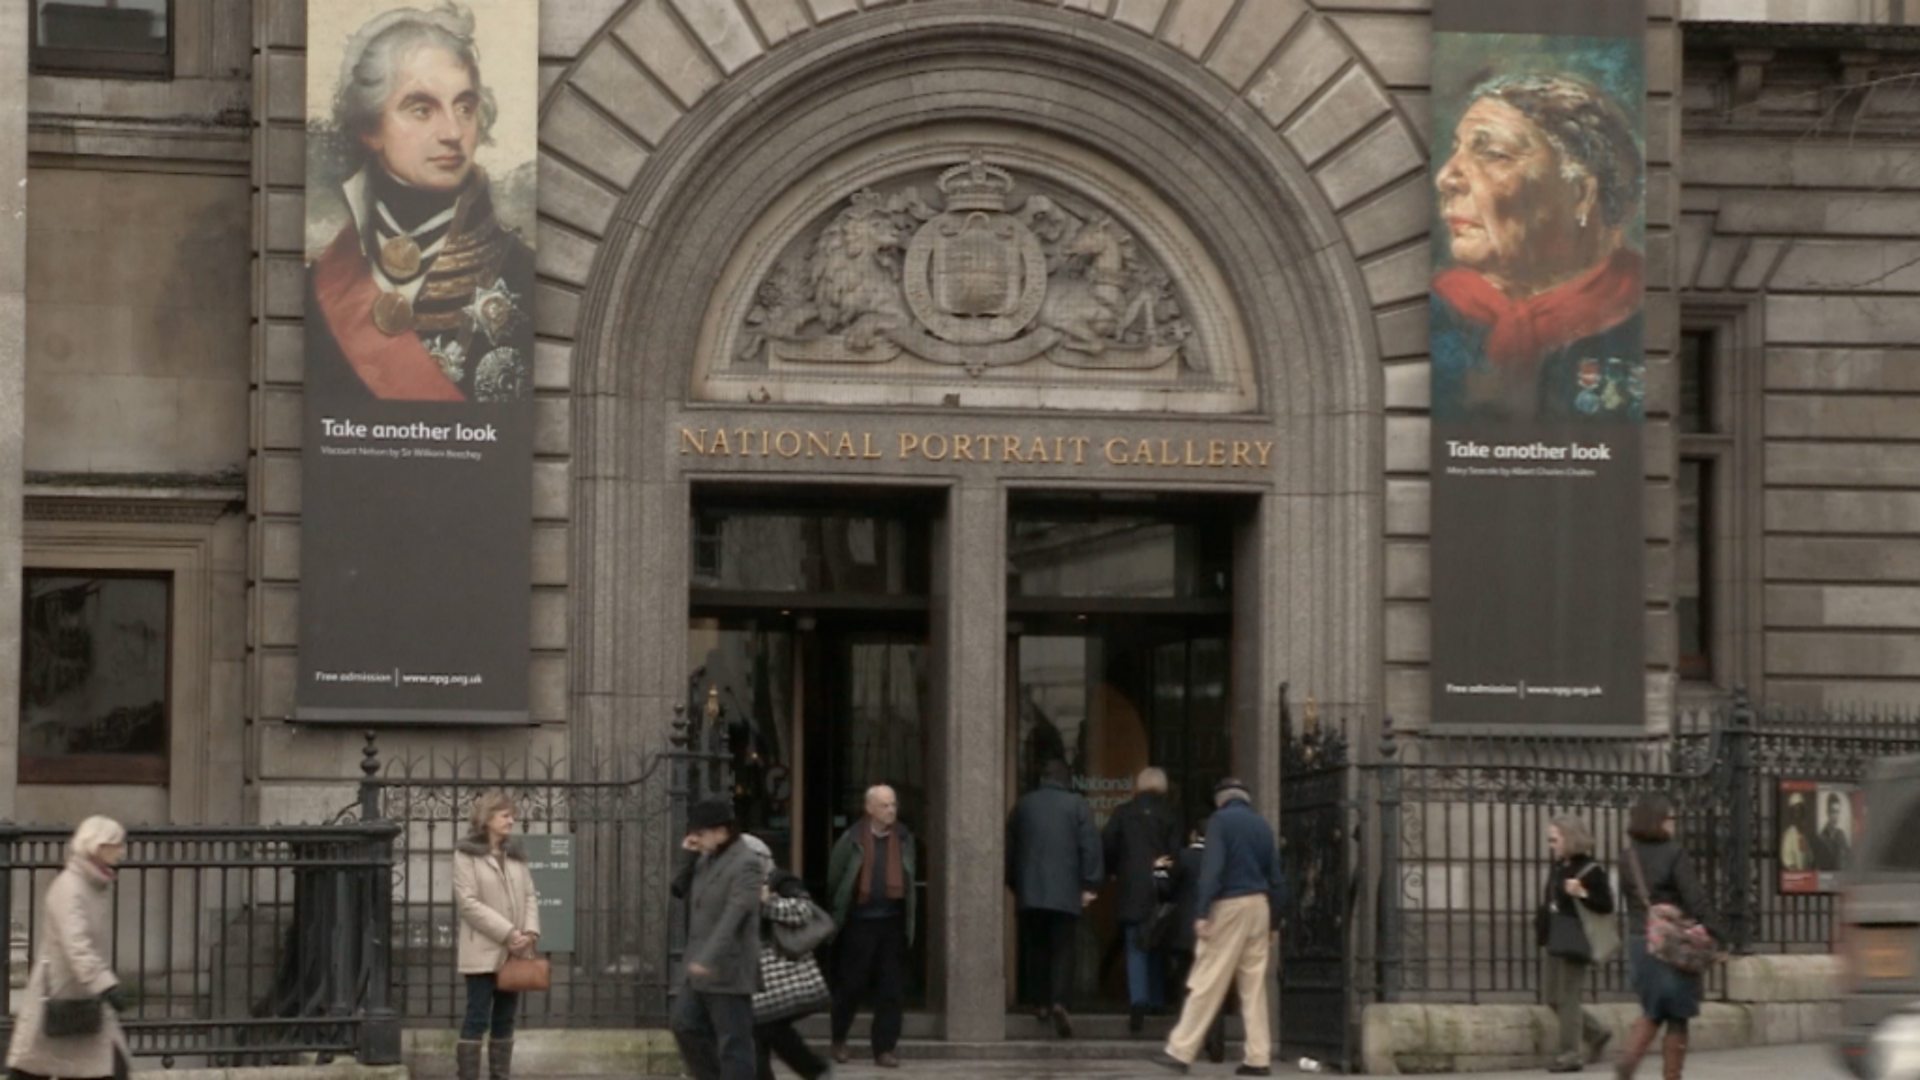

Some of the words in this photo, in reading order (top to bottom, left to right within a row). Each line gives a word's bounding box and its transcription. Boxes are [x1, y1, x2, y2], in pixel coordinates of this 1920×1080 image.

[321, 418, 367, 437] Take
[372, 421, 451, 440] another
[456, 422, 497, 441] look
[680, 428, 882, 460] NATIONAL
[899, 431, 1089, 466] PORTRAIT
[1105, 437, 1274, 468] GALLERY
[1446, 440, 1489, 458] Take
[1494, 441, 1567, 459] another
[1571, 442, 1611, 460] look
[315, 671, 338, 682] Free
[340, 671, 392, 683] admission
[402, 673, 482, 686] www.npg.org.uk
[1446, 683, 1467, 693] Free
[1469, 684, 1517, 694] admission
[1527, 685, 1602, 697] www.npg.org.uk
